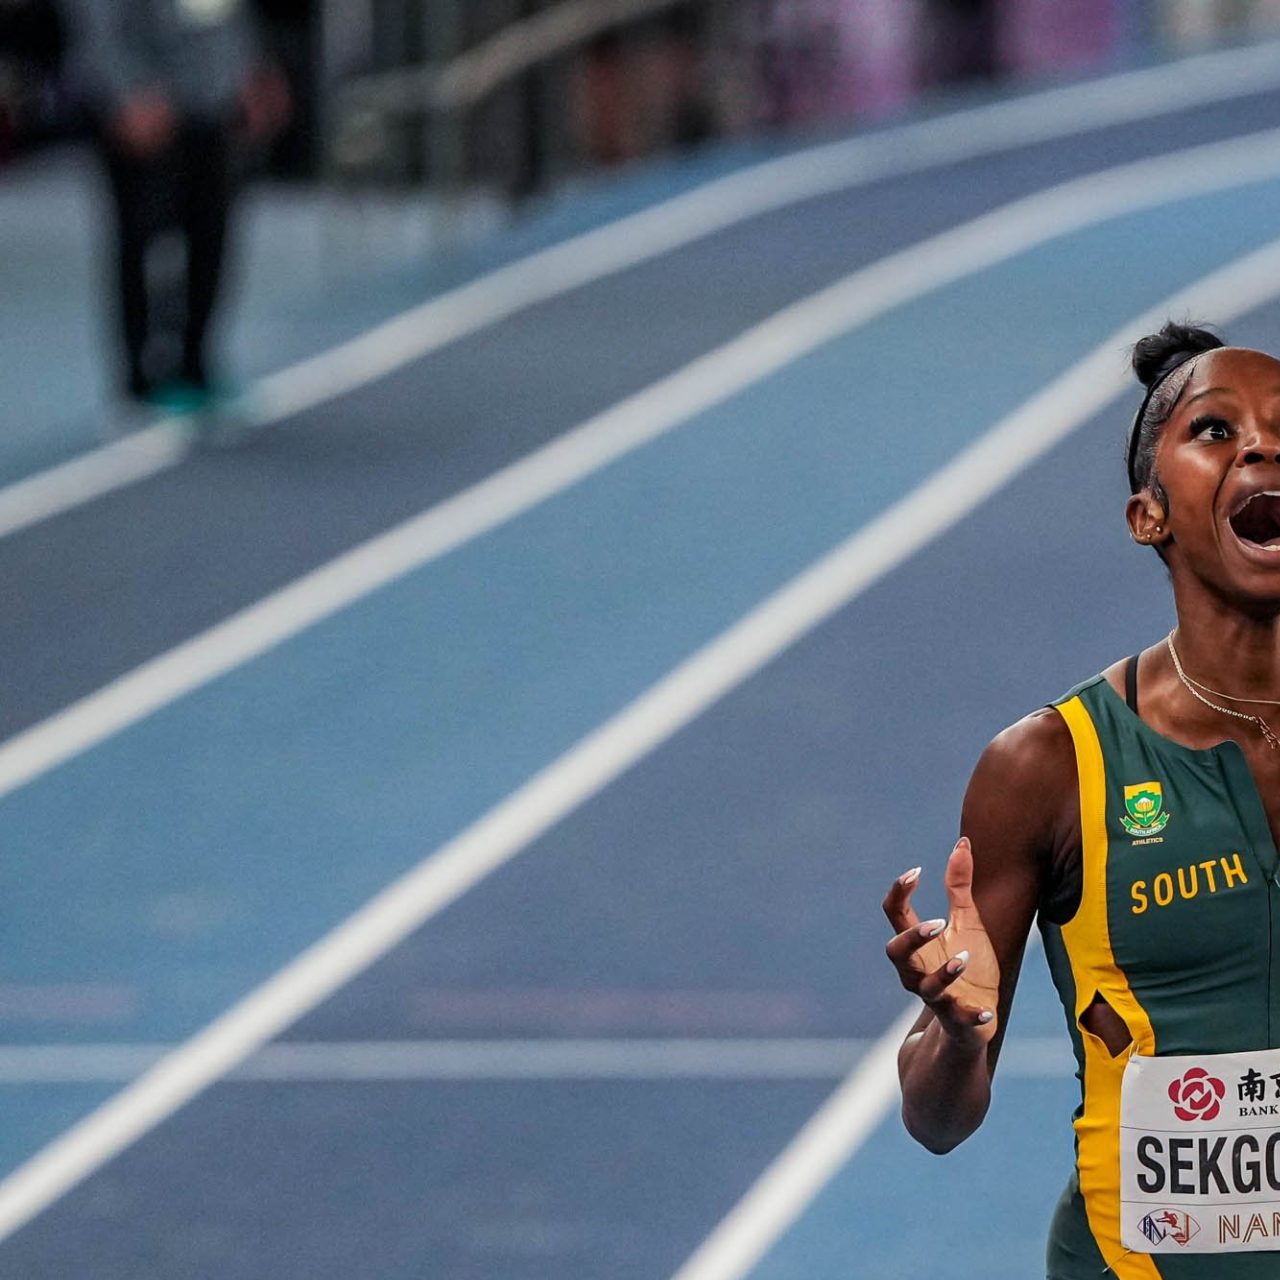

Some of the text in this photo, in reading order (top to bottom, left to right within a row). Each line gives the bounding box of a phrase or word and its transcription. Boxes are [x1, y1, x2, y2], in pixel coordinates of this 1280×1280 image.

[1132, 837, 1163, 846] ATHLETICS
[1131, 853, 1248, 914] SOUTH
[1239, 1104, 1279, 1117] BANK
